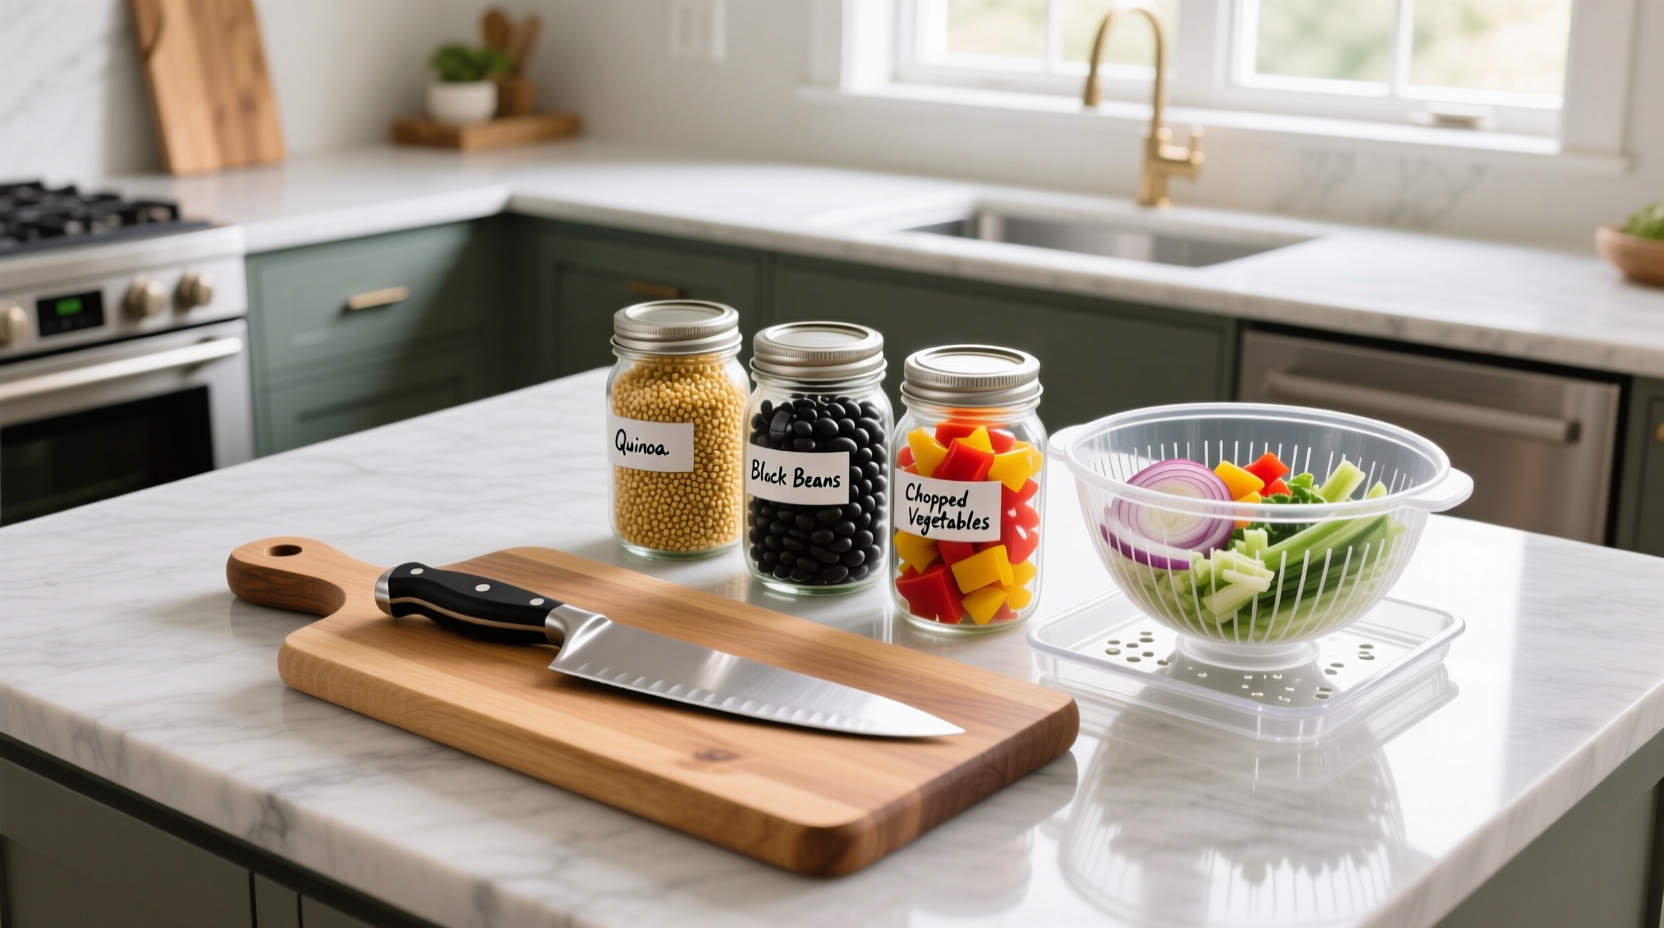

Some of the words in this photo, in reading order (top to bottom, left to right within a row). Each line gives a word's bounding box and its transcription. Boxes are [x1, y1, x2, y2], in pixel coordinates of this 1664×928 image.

[615, 428, 670, 457] Quinoa
[793, 466, 841, 489] Beans
[905, 482, 969, 514] Chopped
[908, 506, 990, 536] Vegetables
